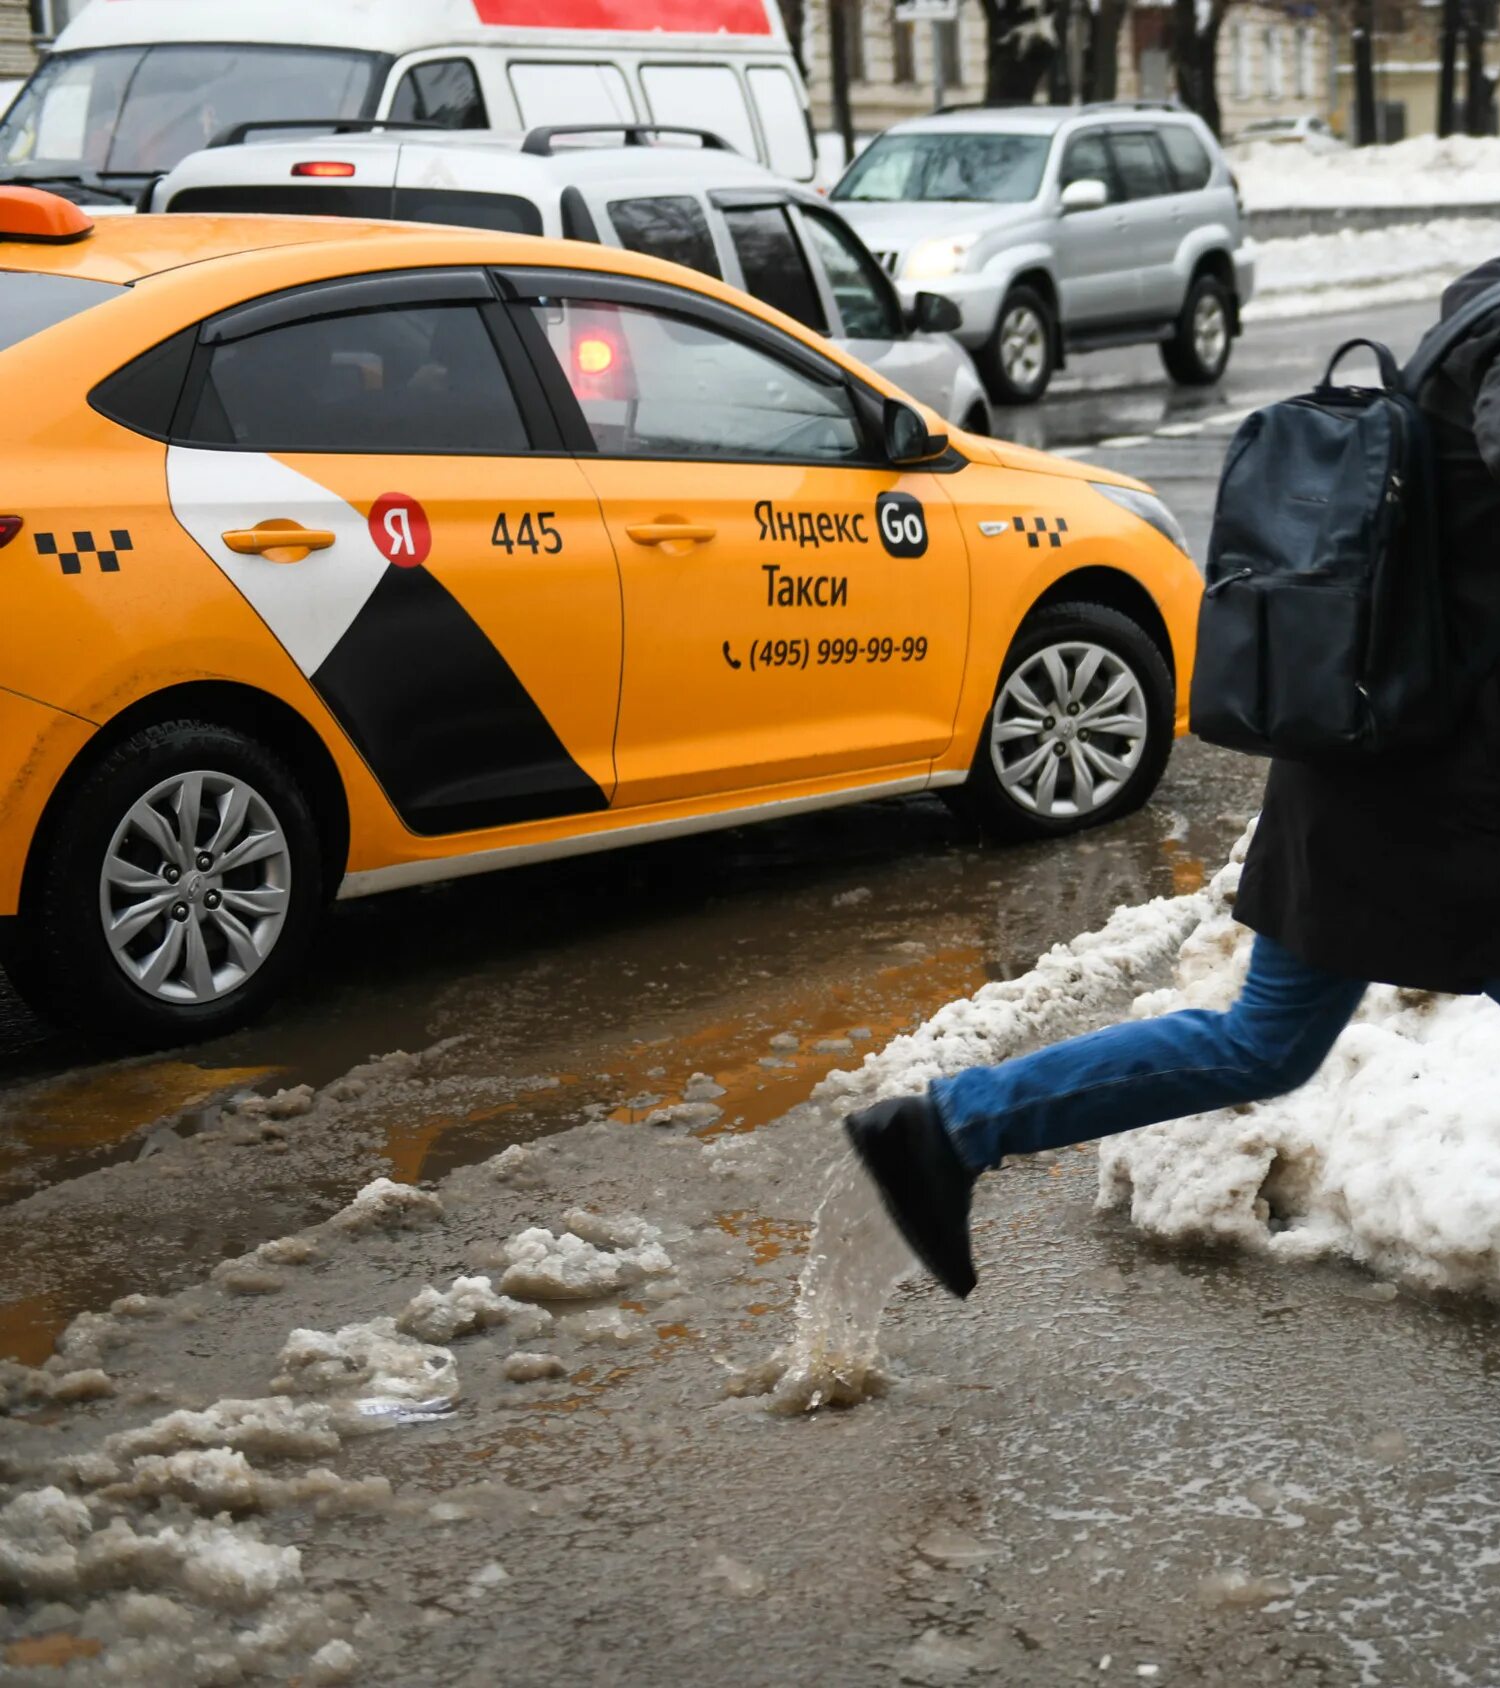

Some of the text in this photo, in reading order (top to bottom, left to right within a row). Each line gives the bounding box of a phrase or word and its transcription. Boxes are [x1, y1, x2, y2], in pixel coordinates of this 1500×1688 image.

[383, 507, 416, 556] Я
[490, 511, 563, 555] 445
[754, 500, 924, 549] Яндекс Go
[761, 564, 848, 608] Такси
[749, 636, 929, 671] (495) 999-99-99
